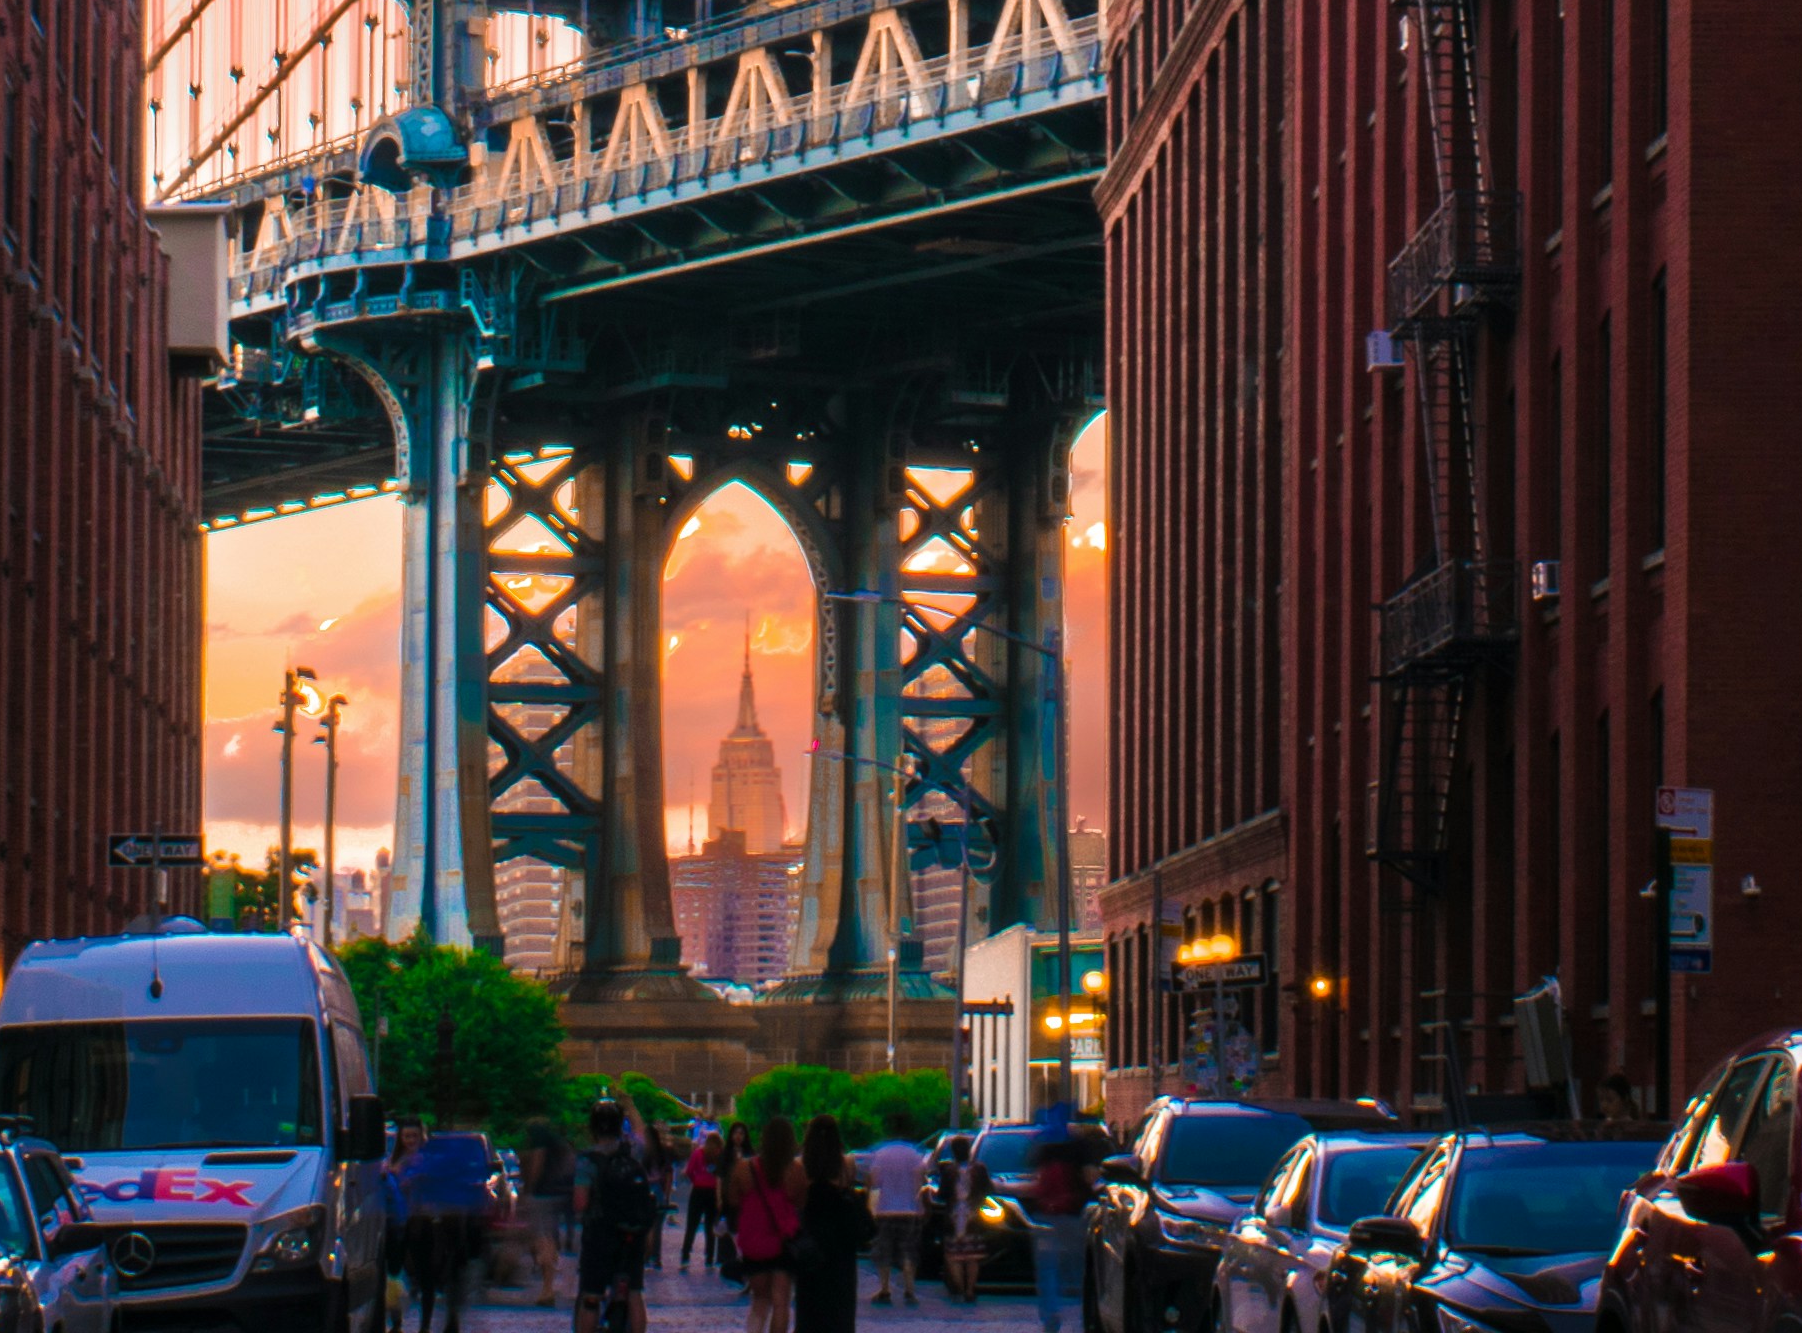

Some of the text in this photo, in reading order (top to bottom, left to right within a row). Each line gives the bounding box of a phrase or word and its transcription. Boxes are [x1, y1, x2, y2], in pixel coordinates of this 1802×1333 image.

[123, 843, 192, 856] ONE WAY
[1185, 964, 1254, 982] ONE WAY
[77, 1168, 256, 1208] edEx
